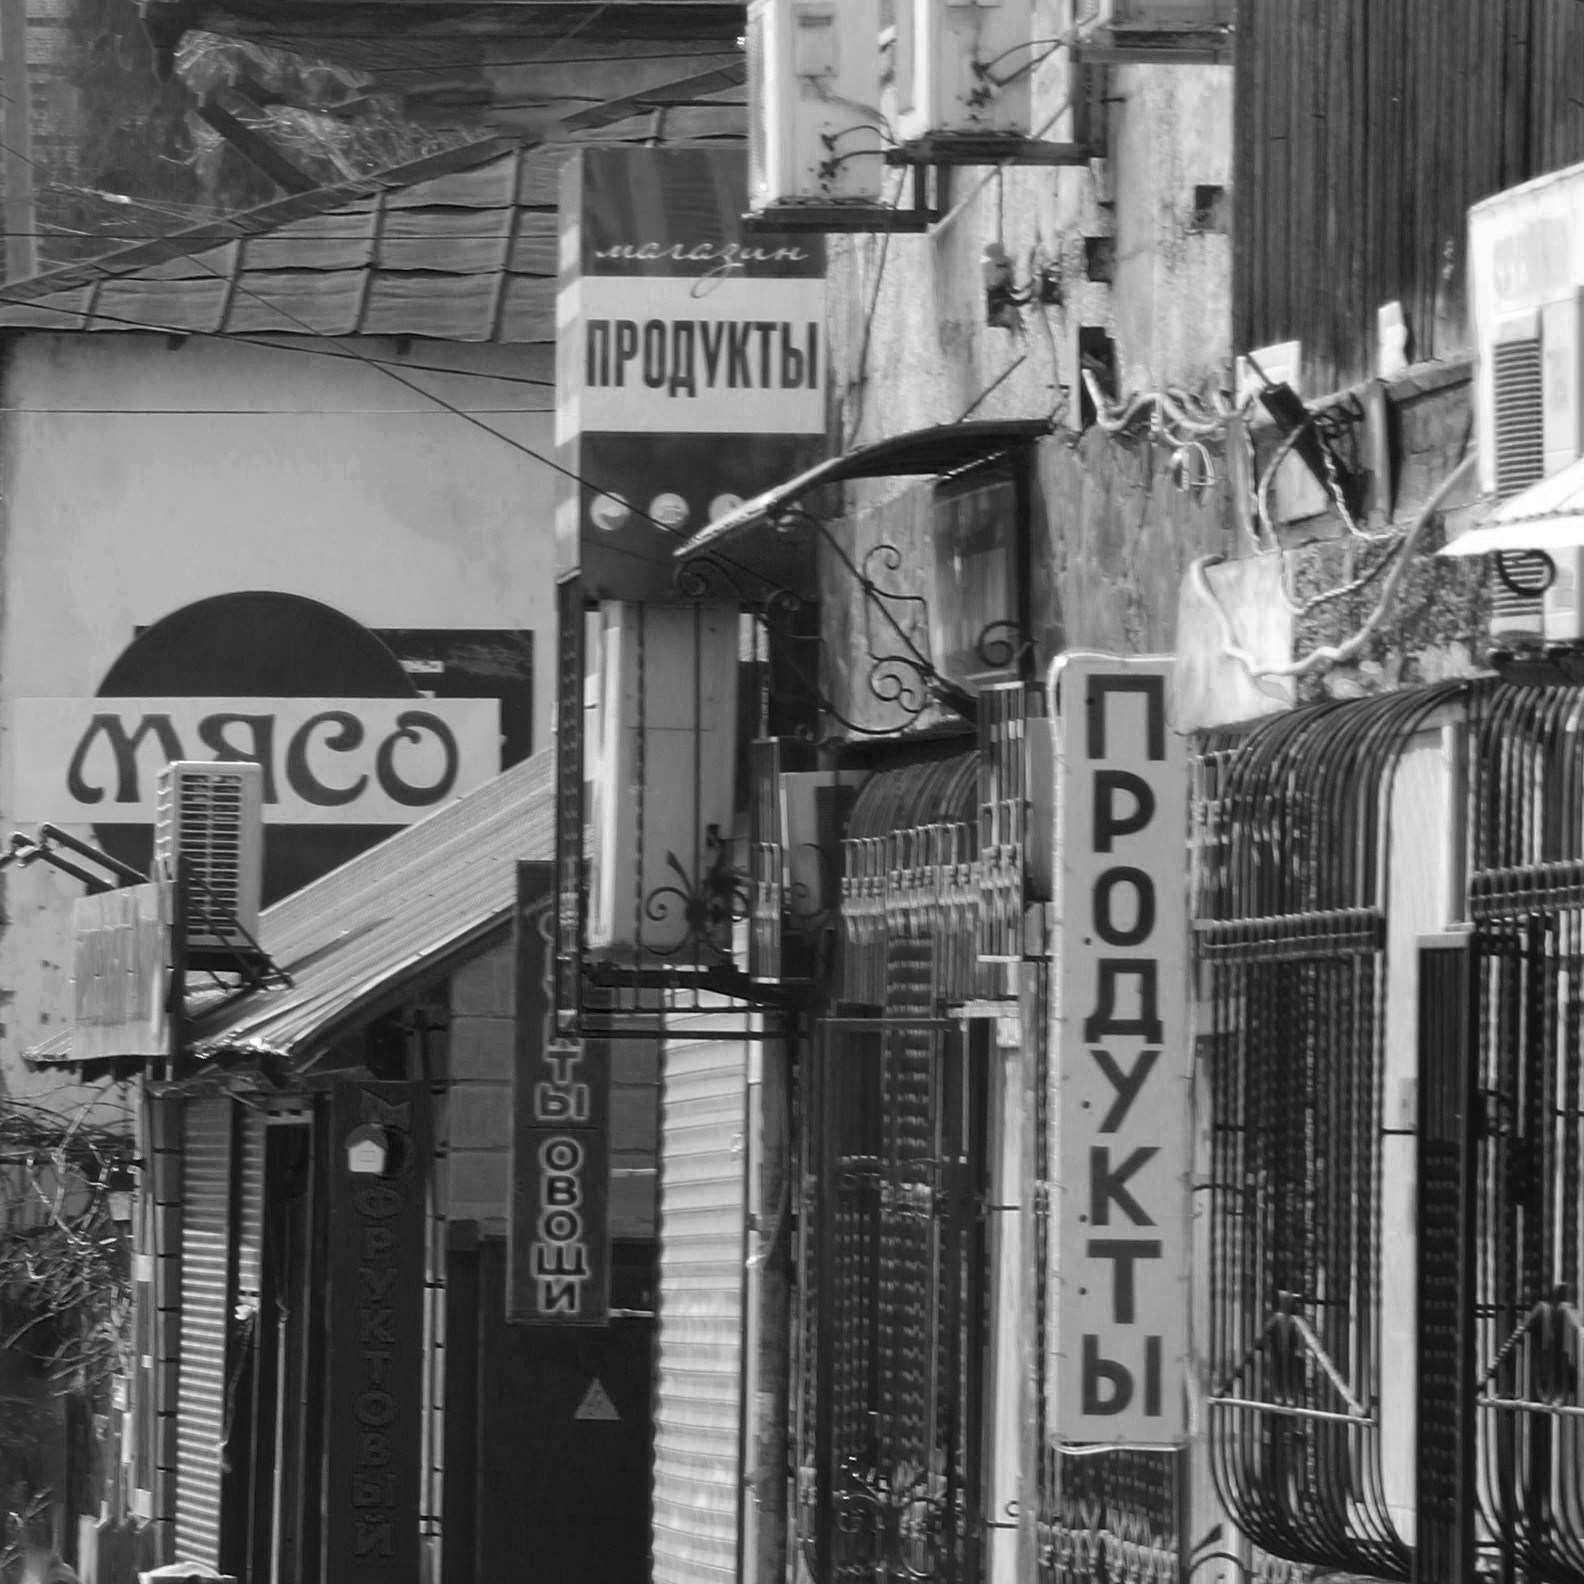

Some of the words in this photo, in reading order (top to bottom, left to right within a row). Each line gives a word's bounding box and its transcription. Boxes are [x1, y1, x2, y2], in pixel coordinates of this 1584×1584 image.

[586, 318, 819, 398] ПРОДУКТЫ
[595, 242, 810, 299] магазин
[1080, 673, 1166, 1418] ПРОДУКТЫ
[531, 1136, 592, 1314] ОВОЩИ
[351, 1185, 404, 1559] ФРУКТОВЫЙ
